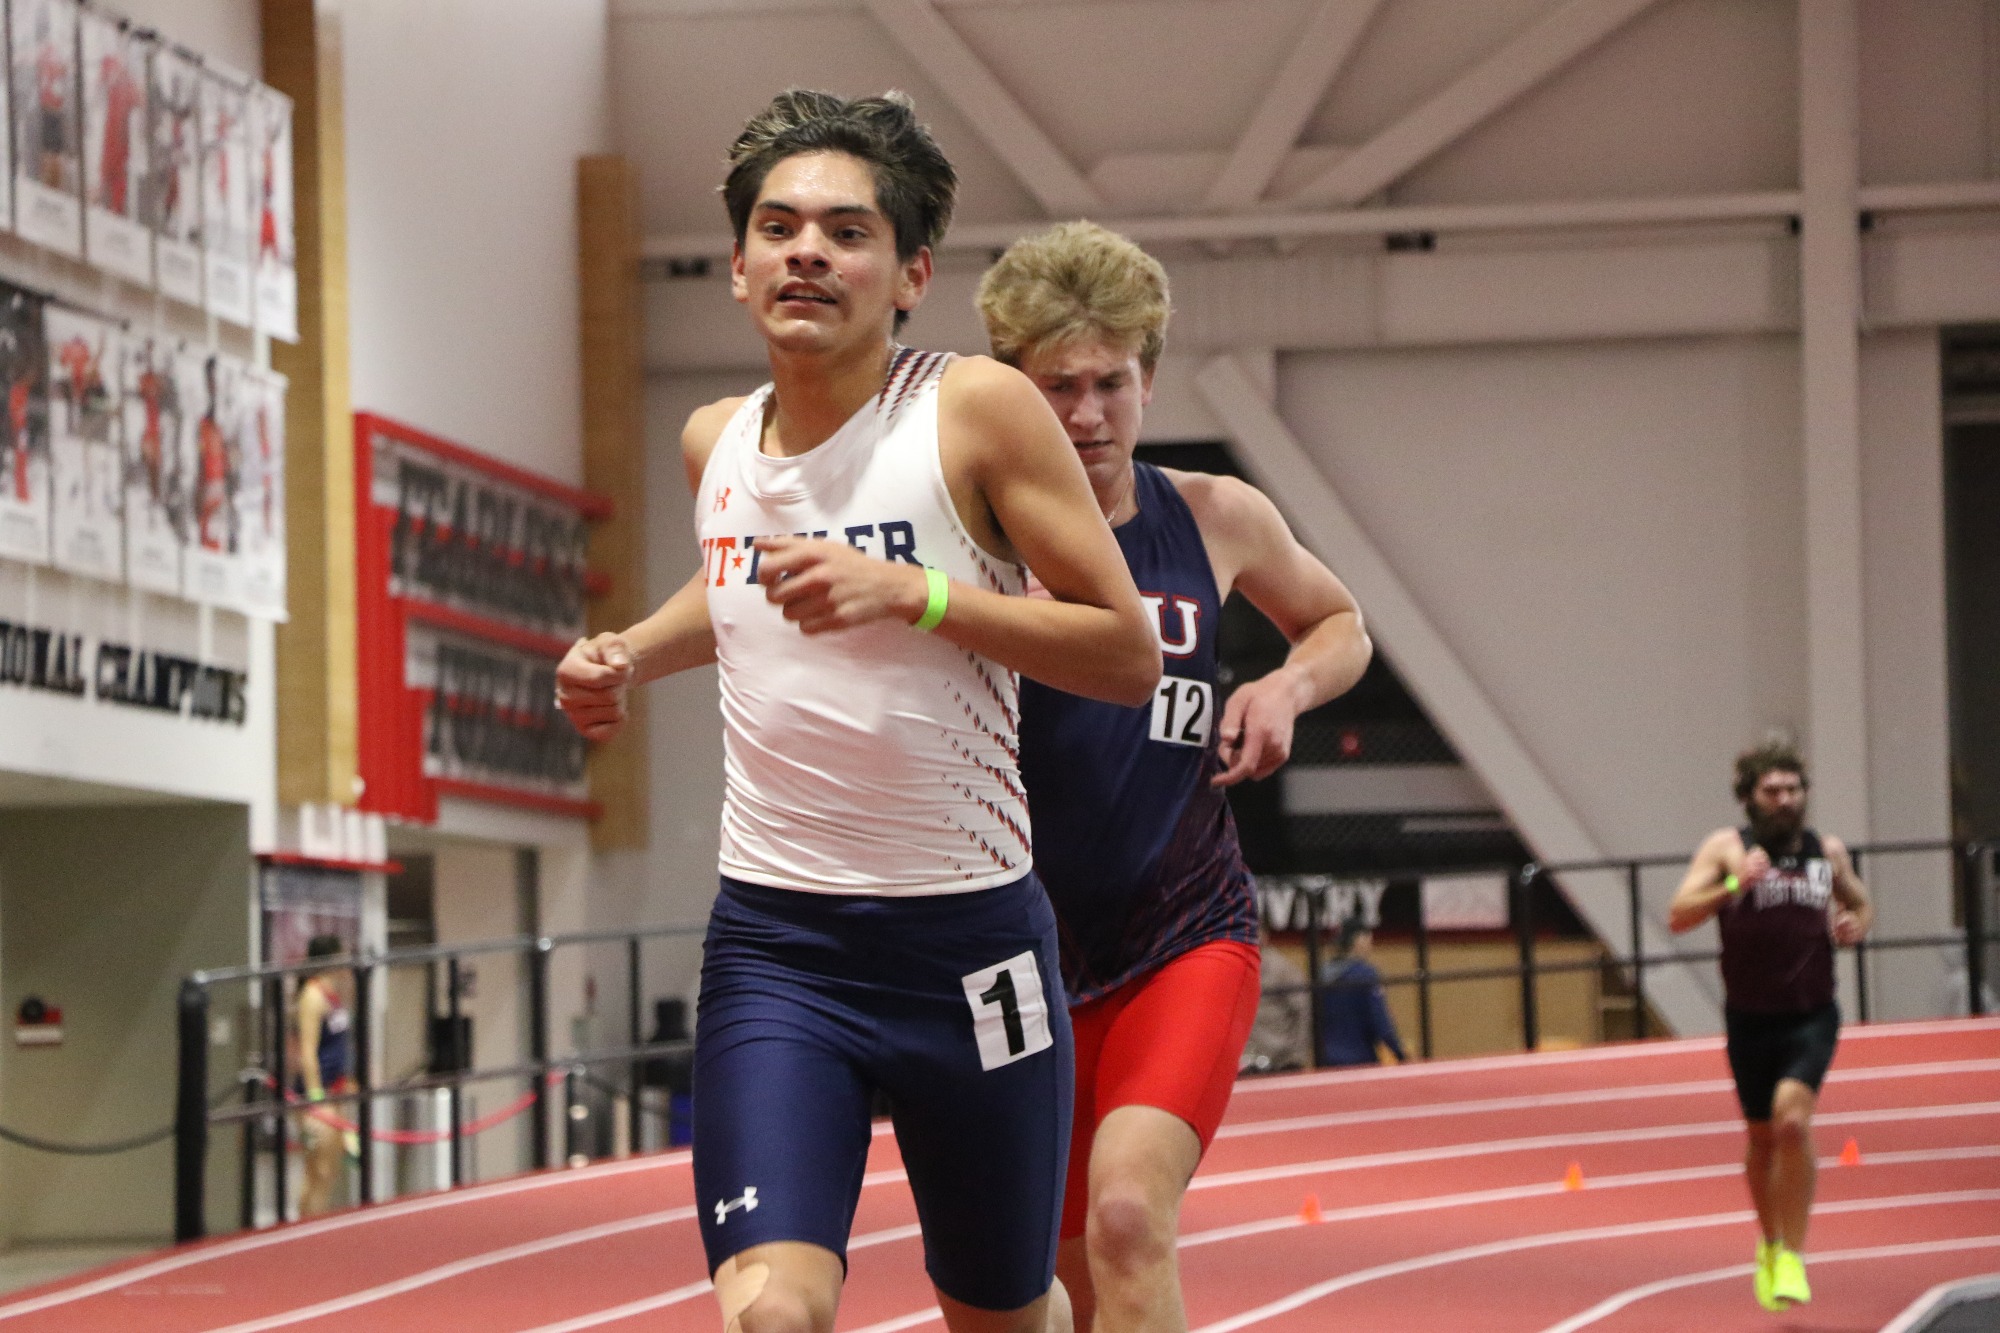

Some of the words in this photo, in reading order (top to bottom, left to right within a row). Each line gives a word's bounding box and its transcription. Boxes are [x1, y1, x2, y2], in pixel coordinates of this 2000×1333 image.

[744, 521, 933, 585] TER
[1160, 681, 1206, 743] 12
[980, 968, 1026, 1057] 1
